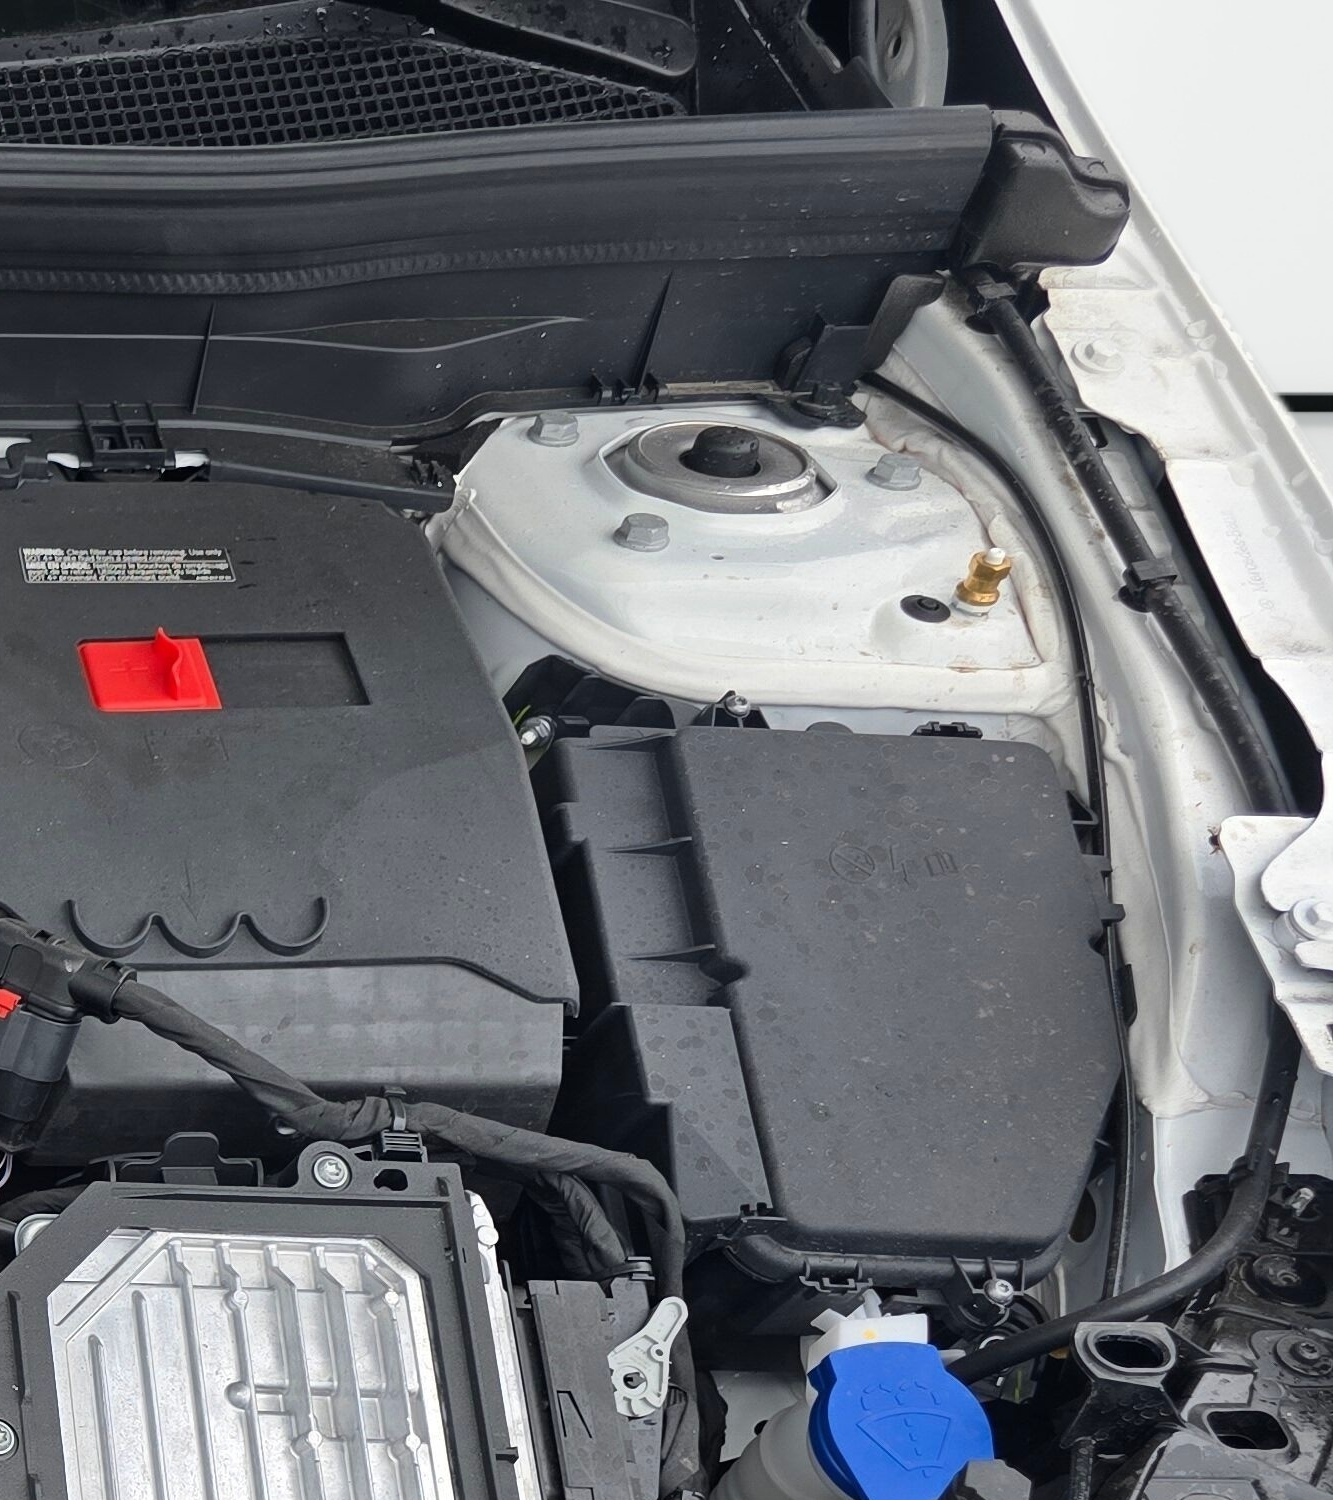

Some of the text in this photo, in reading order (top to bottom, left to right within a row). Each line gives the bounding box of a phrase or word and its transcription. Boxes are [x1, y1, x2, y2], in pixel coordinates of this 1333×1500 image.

[23, 548, 65, 557] WARNING:
[66, 548, 89, 557] Clean
[90, 548, 107, 557] filler
[108, 548, 123, 557] cap
[124, 548, 149, 557] before
[188, 548, 205, 557] Use
[205, 548, 222, 557] only
[47, 561, 60, 570] EN
